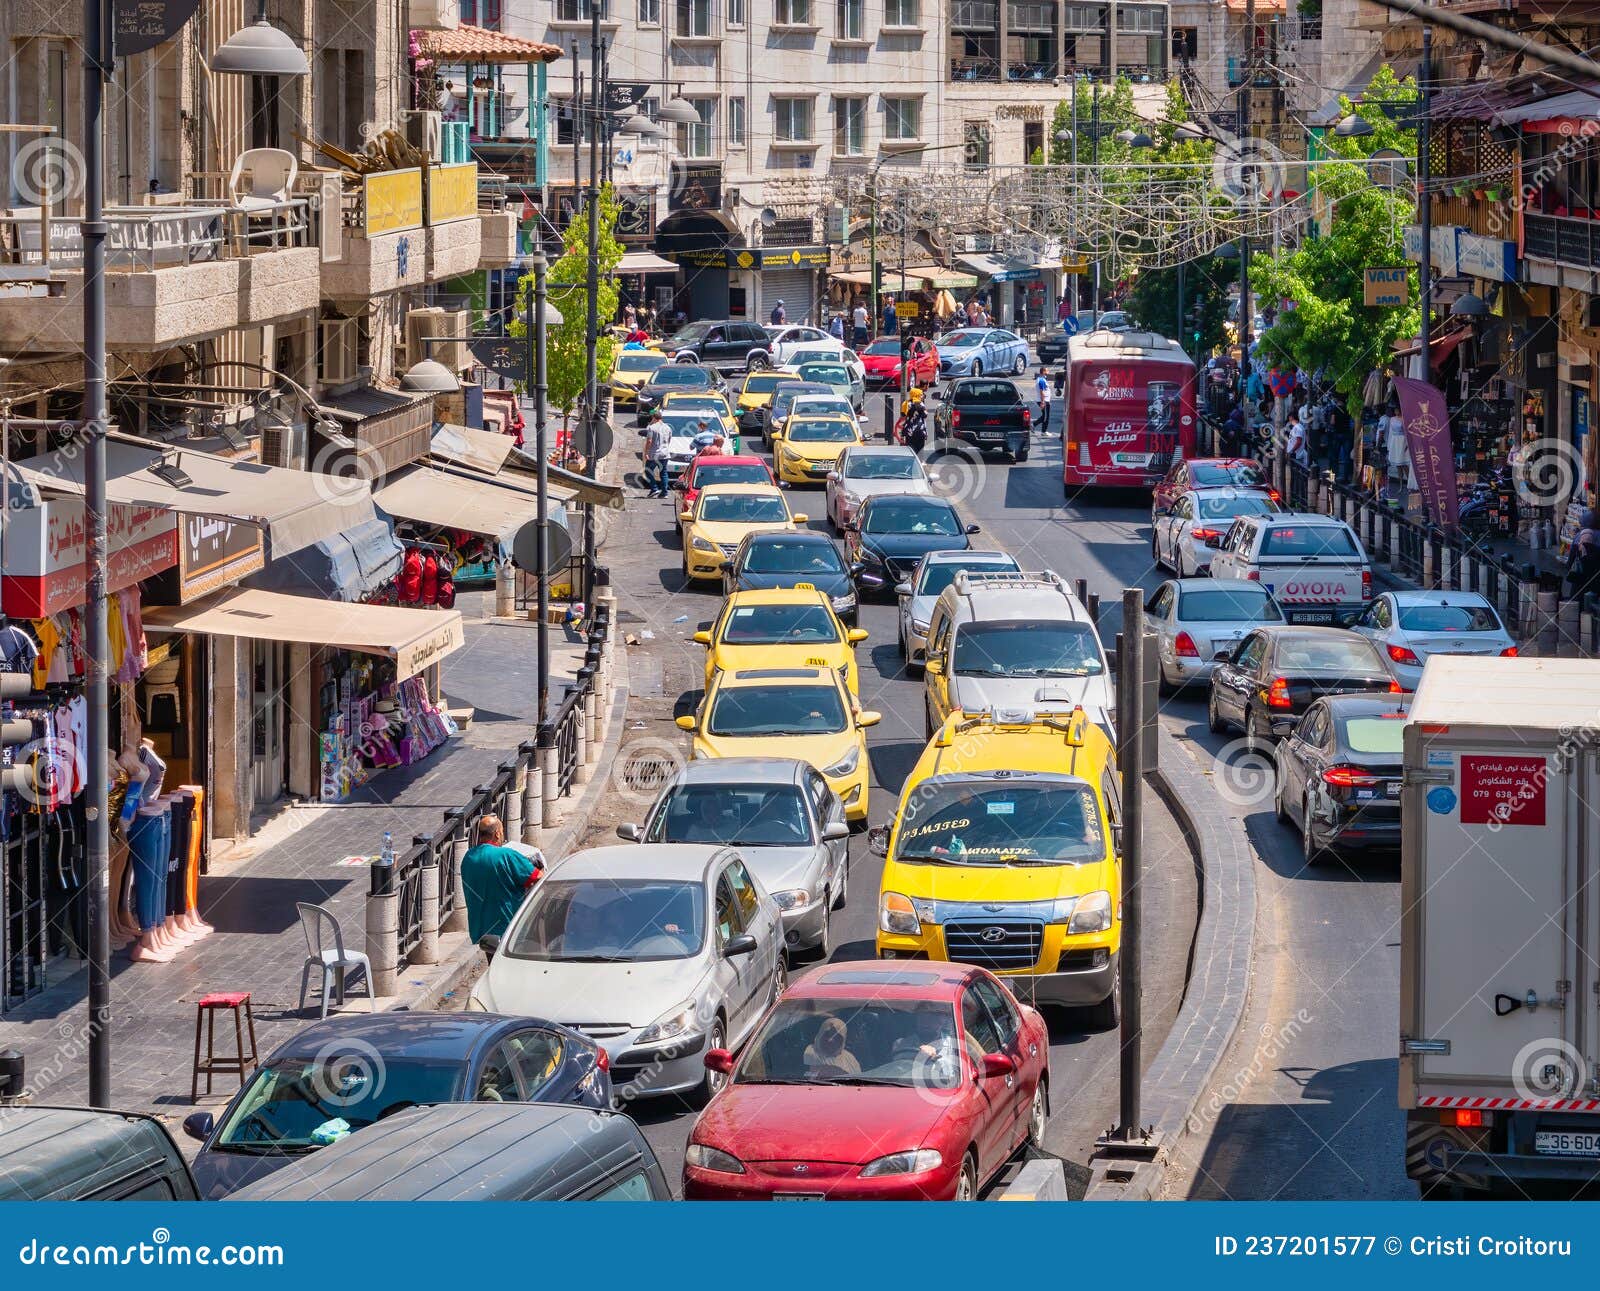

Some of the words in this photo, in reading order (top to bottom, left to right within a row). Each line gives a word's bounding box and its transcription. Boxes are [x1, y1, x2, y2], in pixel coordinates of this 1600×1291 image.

[1368, 269, 1406, 282] VALET
[1110, 367, 1135, 389] BM
[1105, 422, 1132, 433] خليك
[1285, 582, 1347, 595] OYOTA
[809, 657, 827, 666] TAXI
[1520, 764, 1537, 772] كيف
[1473, 789, 1490, 798] 079
[1495, 790, 1512, 799] 638
